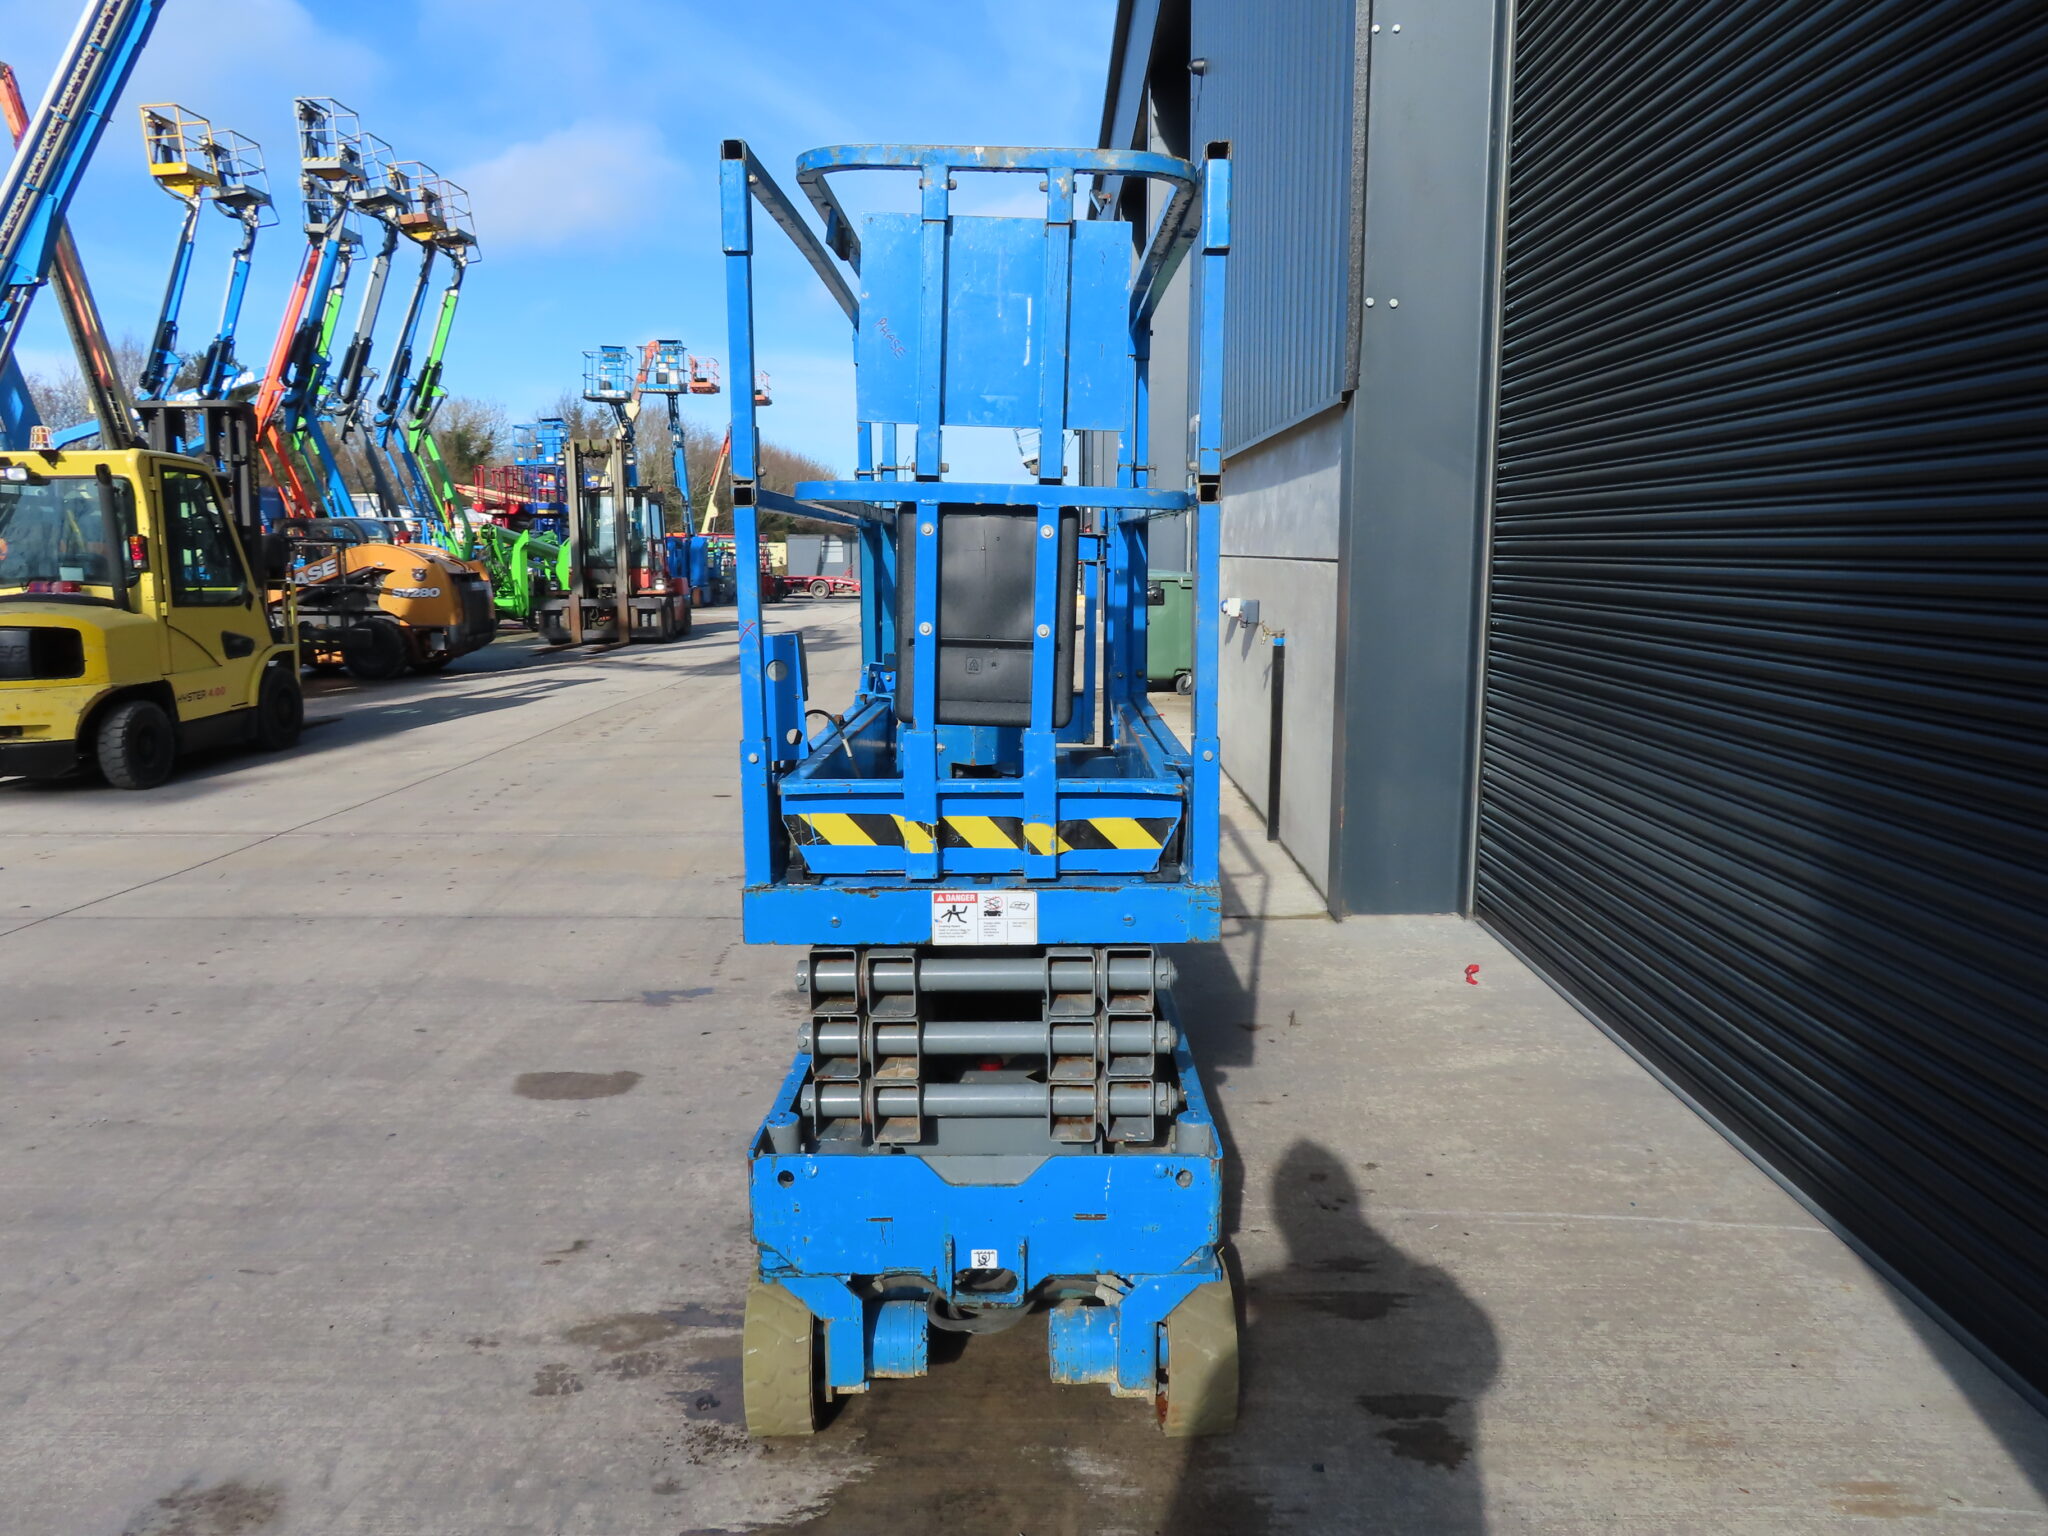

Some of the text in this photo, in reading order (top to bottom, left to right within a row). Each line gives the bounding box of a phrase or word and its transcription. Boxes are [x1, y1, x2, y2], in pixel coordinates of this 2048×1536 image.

[872, 317, 907, 360] PHASE
[294, 558, 337, 584] ASE
[391, 587, 441, 598] SV280
[945, 894, 976, 902] DANGER
